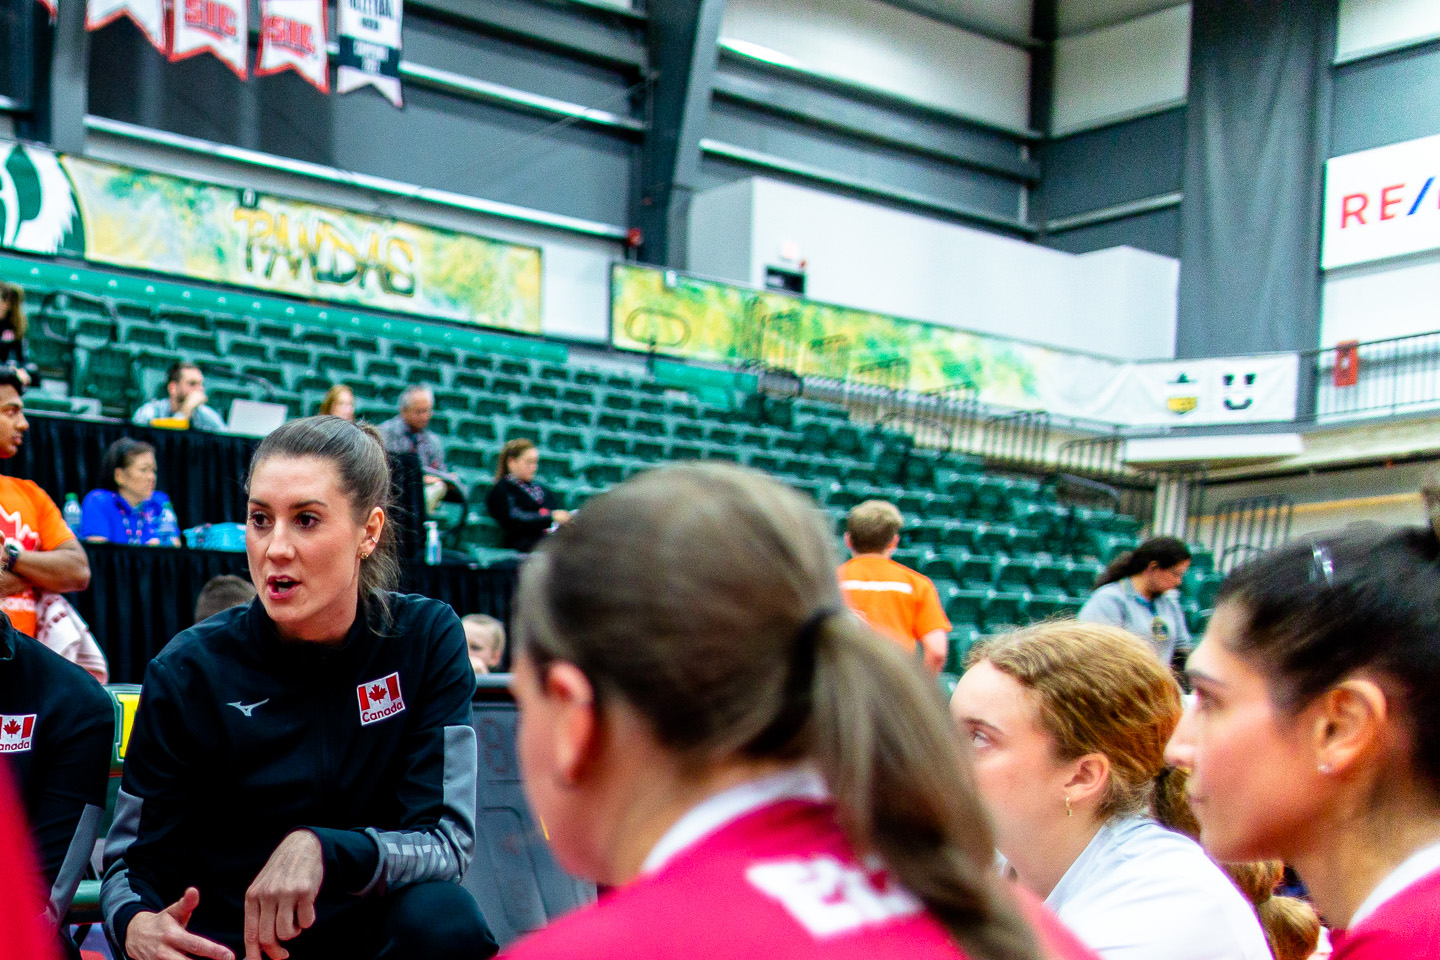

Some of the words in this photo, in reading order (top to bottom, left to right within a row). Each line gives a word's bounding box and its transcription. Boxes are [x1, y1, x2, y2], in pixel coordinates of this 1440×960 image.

[1340, 176, 1440, 229] RE/
[234, 205, 416, 298] PANDAS
[362, 701, 403, 723] Canada
